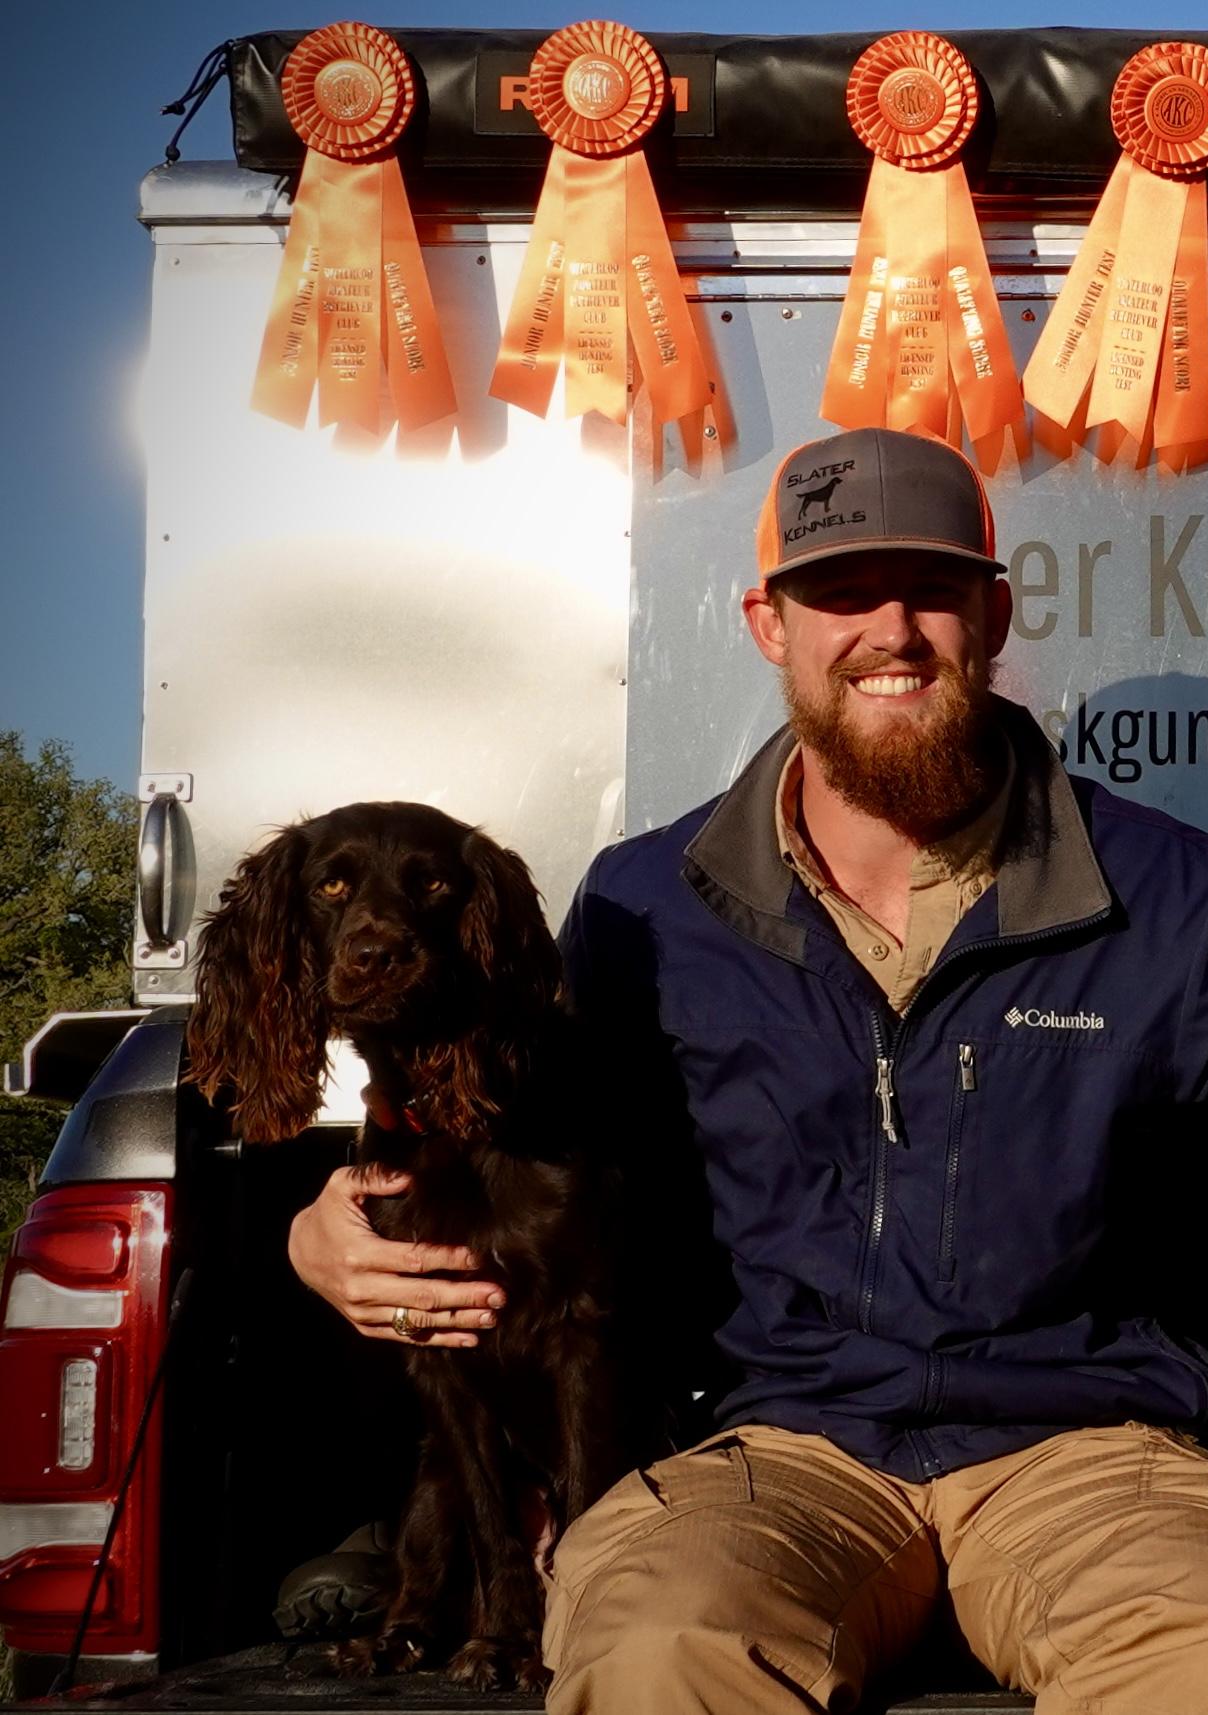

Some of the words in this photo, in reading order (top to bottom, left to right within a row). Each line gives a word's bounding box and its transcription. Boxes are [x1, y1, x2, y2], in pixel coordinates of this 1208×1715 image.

[1163, 96, 1193, 126] AKC
[1074, 281, 1104, 328] HUNTER
[1096, 249, 1116, 277] TEST
[1172, 280, 1189, 351] QUALIFYING
[520, 327, 544, 370] JUNIOR
[1121, 328, 1143, 342] CLUB
[1115, 378, 1133, 391] TEST
[1174, 353, 1191, 394] SCORE
[787, 460, 856, 488] SLATER
[784, 511, 866, 545] KENNELS
[1008, 538, 1112, 640] er
[1025, 1009, 1104, 1029] Columbia
